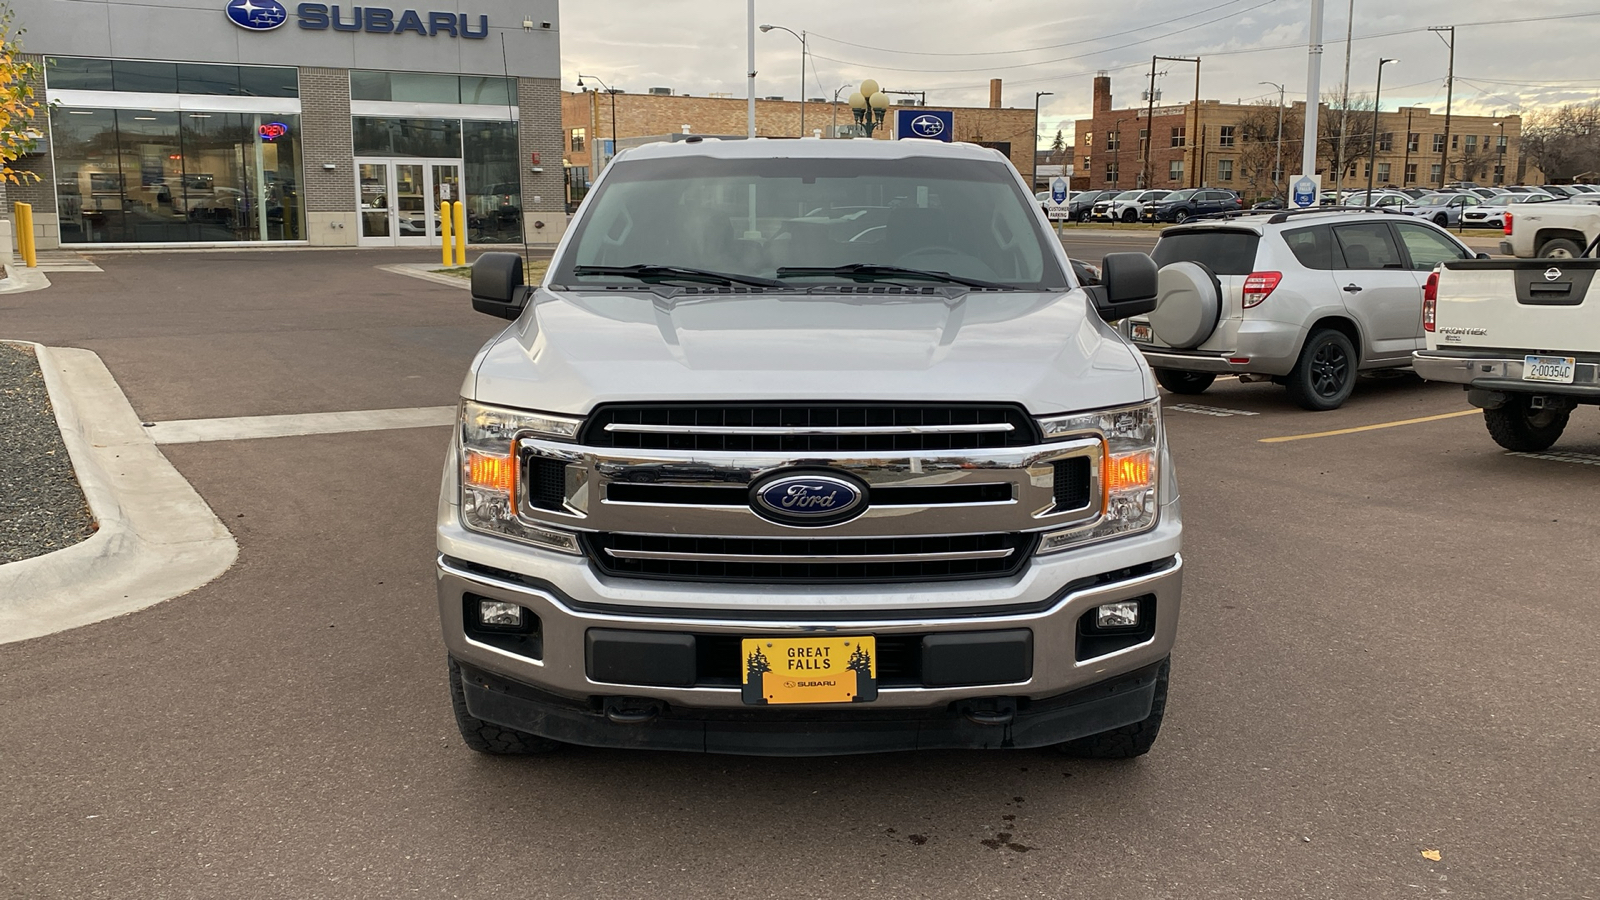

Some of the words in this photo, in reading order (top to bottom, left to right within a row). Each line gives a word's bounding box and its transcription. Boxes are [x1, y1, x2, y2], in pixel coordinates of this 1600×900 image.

[297, 2, 488, 39] SUBARU
[259, 125, 284, 136] OPEN
[1439, 326, 1487, 336] FRONTIER
[781, 484, 837, 508] Ford
[787, 646, 831, 658] GREAT
[787, 658, 831, 670] FALLS
